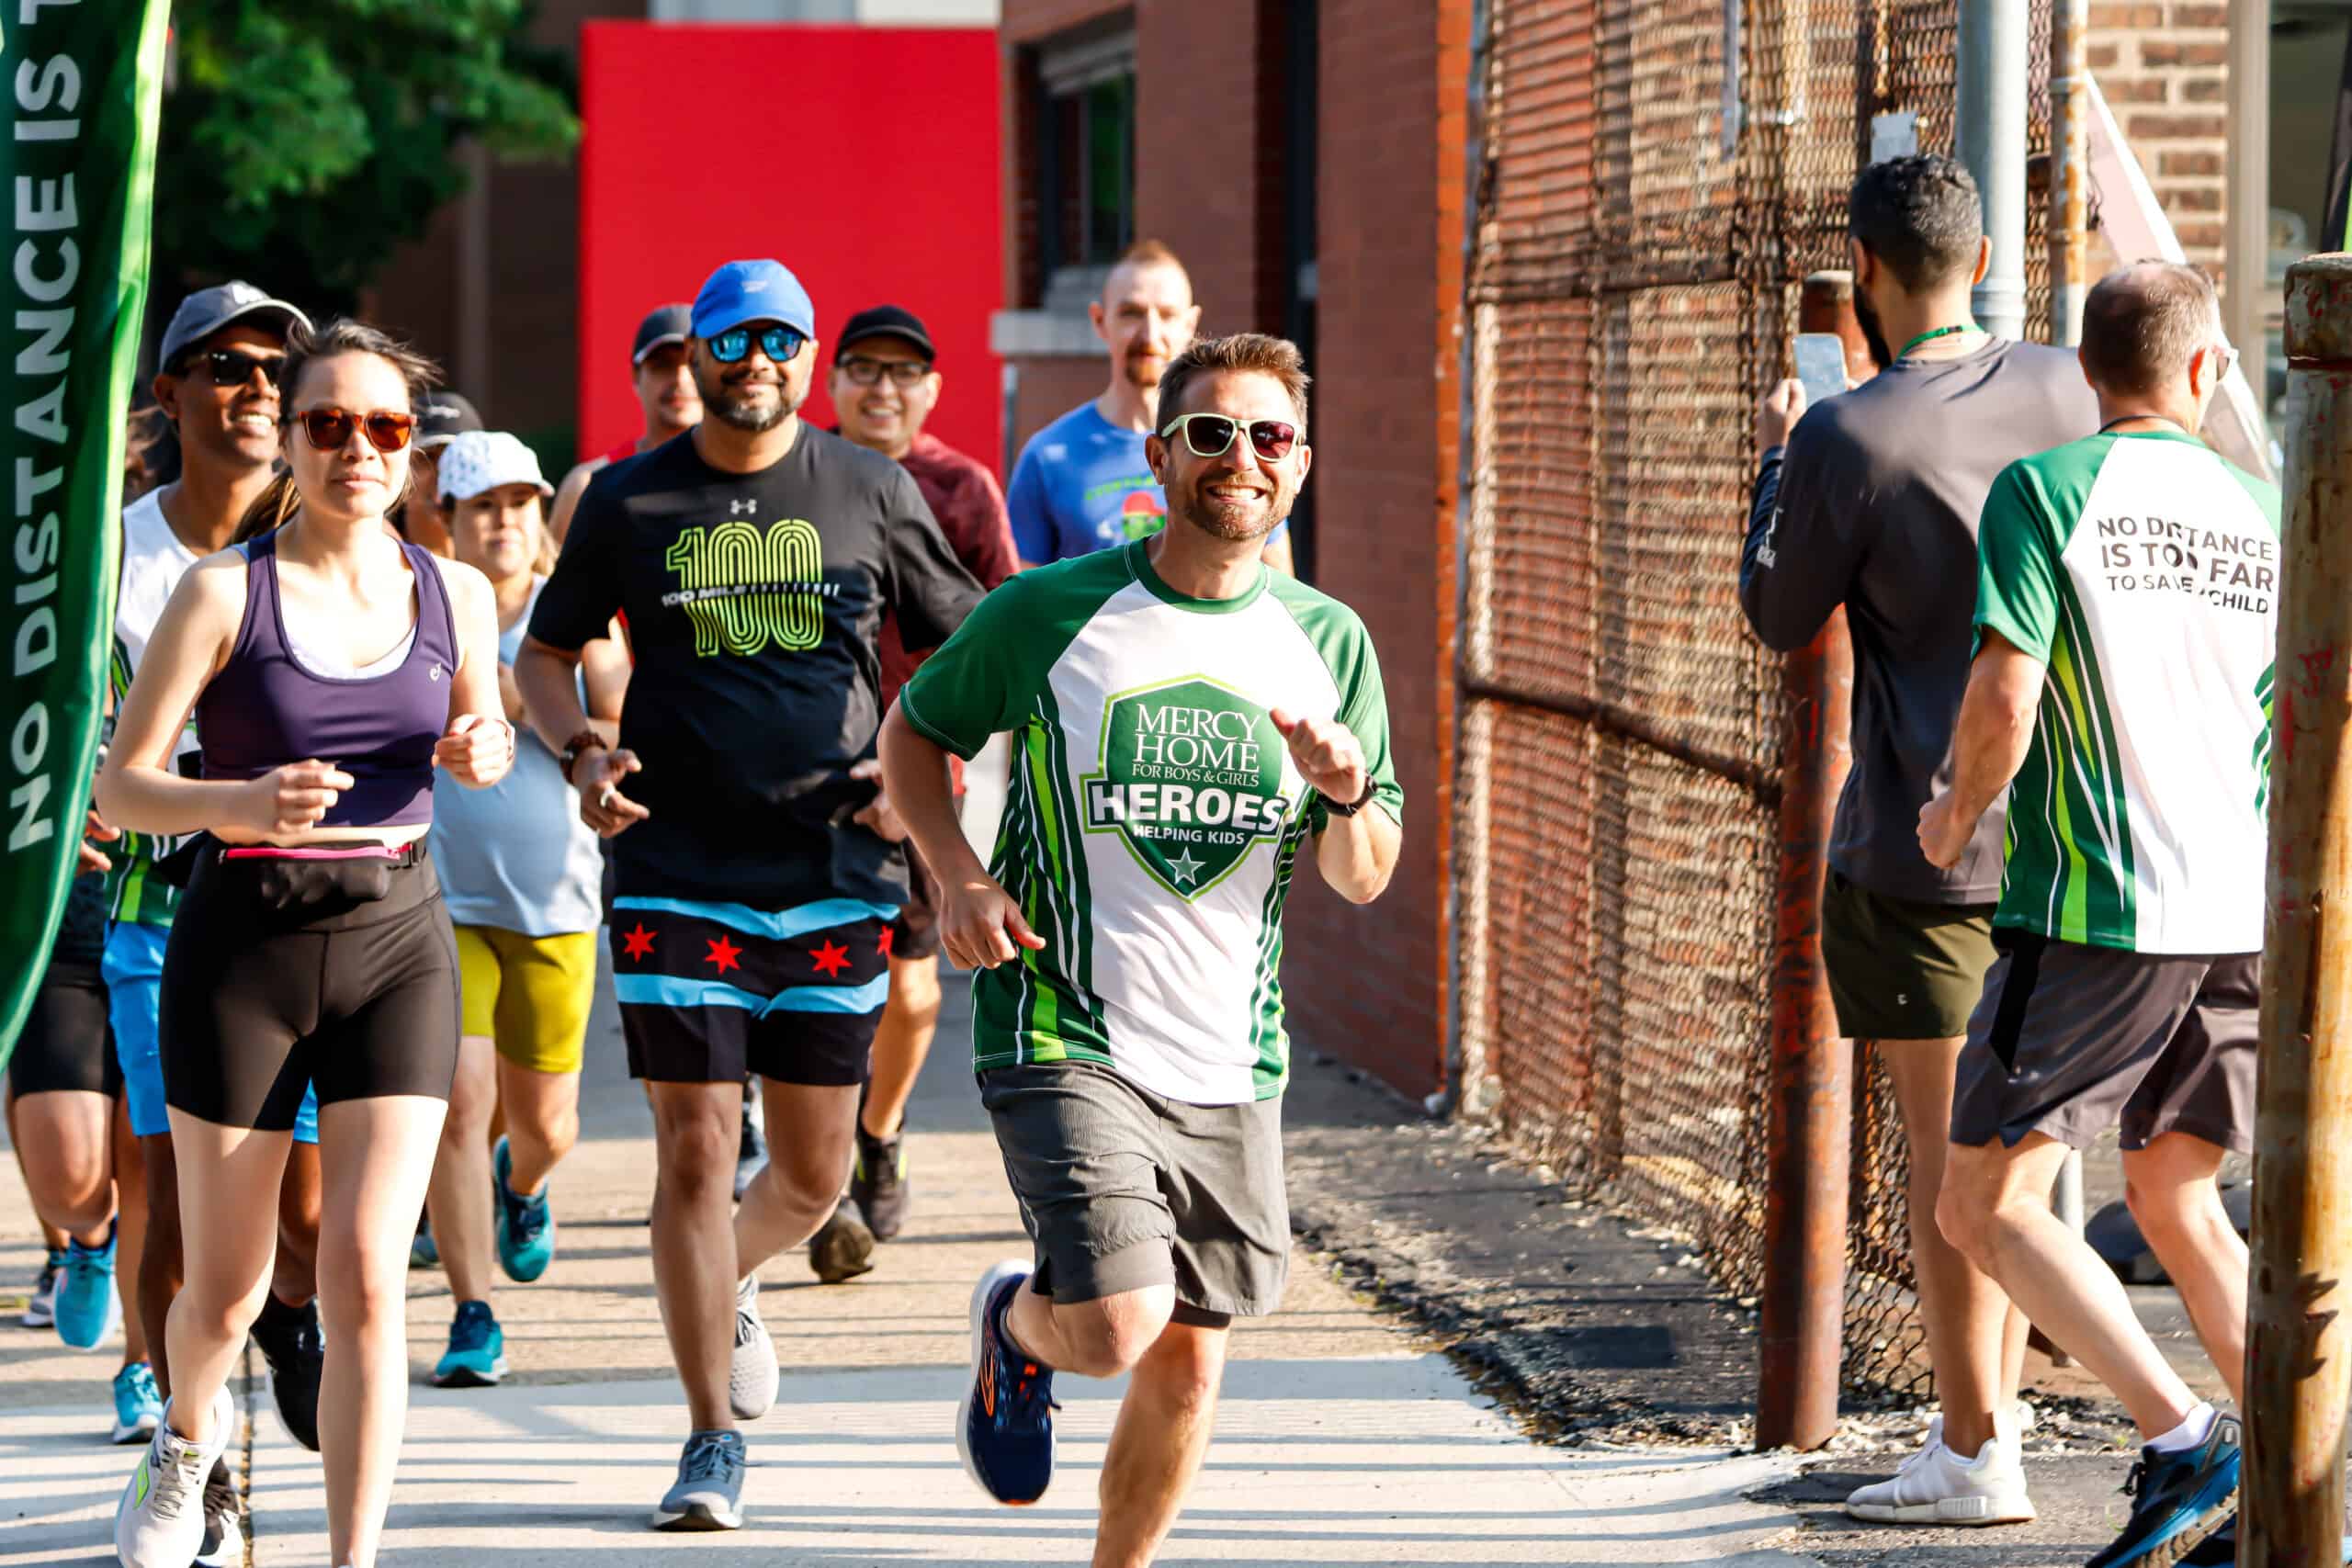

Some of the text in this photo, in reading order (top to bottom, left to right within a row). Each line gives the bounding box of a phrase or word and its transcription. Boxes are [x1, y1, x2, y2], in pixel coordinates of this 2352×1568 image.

[14, 53, 82, 141] IS
[14, 172, 81, 677] DISTANCE
[2097, 516, 2138, 537] NO
[666, 518, 823, 657] 100
[2101, 543, 2132, 569] IS
[2210, 558, 2272, 592] FAR
[2106, 574, 2136, 592] TO
[2208, 590, 2268, 615] CHILD
[1135, 703, 1261, 744] MERCY
[1132, 733, 1261, 773] HOME
[1132, 763, 1260, 787] FOR BOYS & GIRLS
[7, 701, 53, 852] NO
[1091, 784, 1285, 832] HEROES
[1133, 824, 1245, 845] HELPING KIDS
